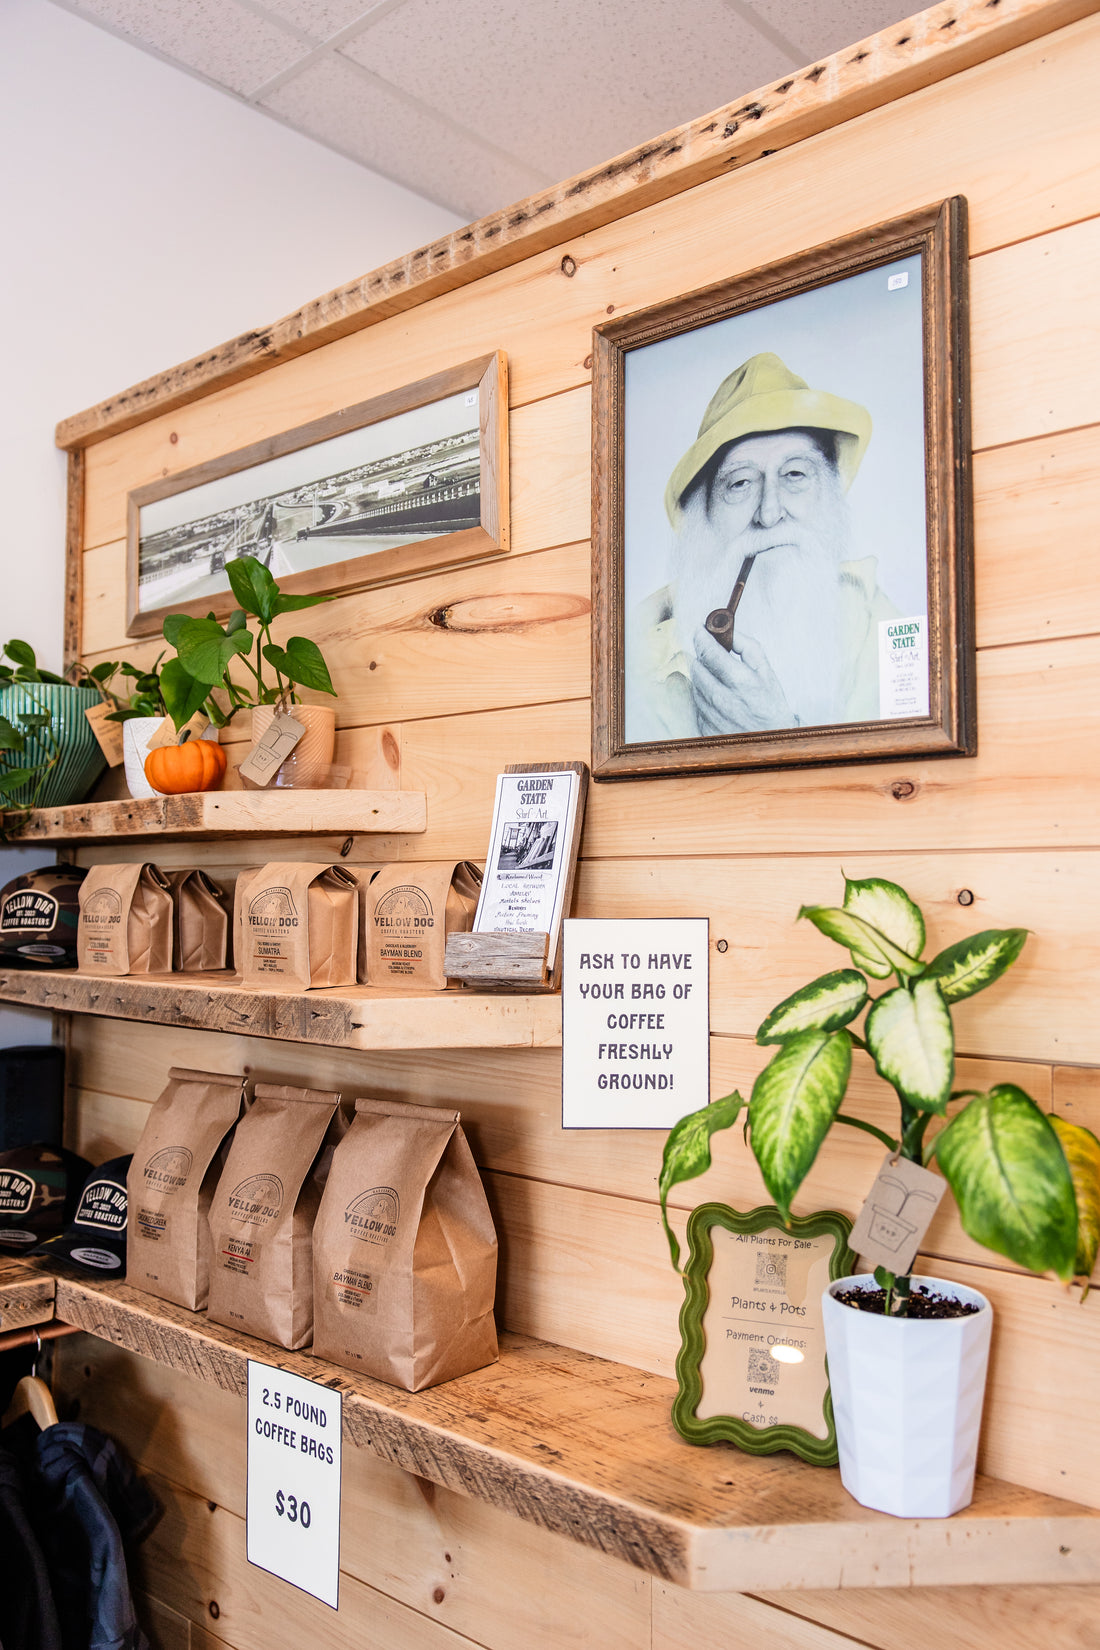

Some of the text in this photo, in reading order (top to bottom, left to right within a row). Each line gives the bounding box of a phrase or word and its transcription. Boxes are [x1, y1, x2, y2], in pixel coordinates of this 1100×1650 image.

[888, 623, 920, 637] GARDEN
[892, 636, 916, 650] STATE
[517, 779, 554, 792] GARDEN
[520, 793, 546, 804] STATE
[516, 808, 548, 819] Surf Art
[6, 896, 54, 914] YELLOW DOG
[3, 918, 50, 926] COFFEE ROASTERS
[82, 915, 121, 923] YELLOW DOG
[248, 916, 299, 927] YELLOW DOG
[374, 917, 434, 927] YELLOW DOG
[258, 946, 280, 956] SUMATRA
[380, 949, 423, 958] BAYMAN BLEND
[580, 954, 692, 970] ASK TO HAVE
[580, 984, 692, 1000] YOUR BAG OF
[607, 1014, 665, 1030] COFFEE
[598, 1044, 673, 1060] FRESHLY
[598, 1074, 674, 1090] GROUND!
[144, 1168, 176, 1185] YELLOW
[10, 1178, 31, 1196] DOG
[86, 1186, 128, 1212] YELLOW DOG
[228, 1197, 280, 1218] YELLOW DOG
[94, 1210, 122, 1224] ROASTERS
[344, 1212, 397, 1236] YELLOW DOG
[228, 1244, 244, 1255] KENYA
[736, 1234, 811, 1249] All Plants For Sale
[334, 1272, 372, 1291] BAYMAN BLEND
[731, 1296, 766, 1312] Plants
[780, 1302, 806, 1316] Pots
[726, 1329, 807, 1348] Payment Options:
[749, 1386, 775, 1396] venmo
[262, 1388, 327, 1428] 2.5 POUND
[742, 1412, 778, 1426] Cash $$
[255, 1418, 334, 1465] COFFEE BAGS
[275, 1489, 311, 1529] $30
